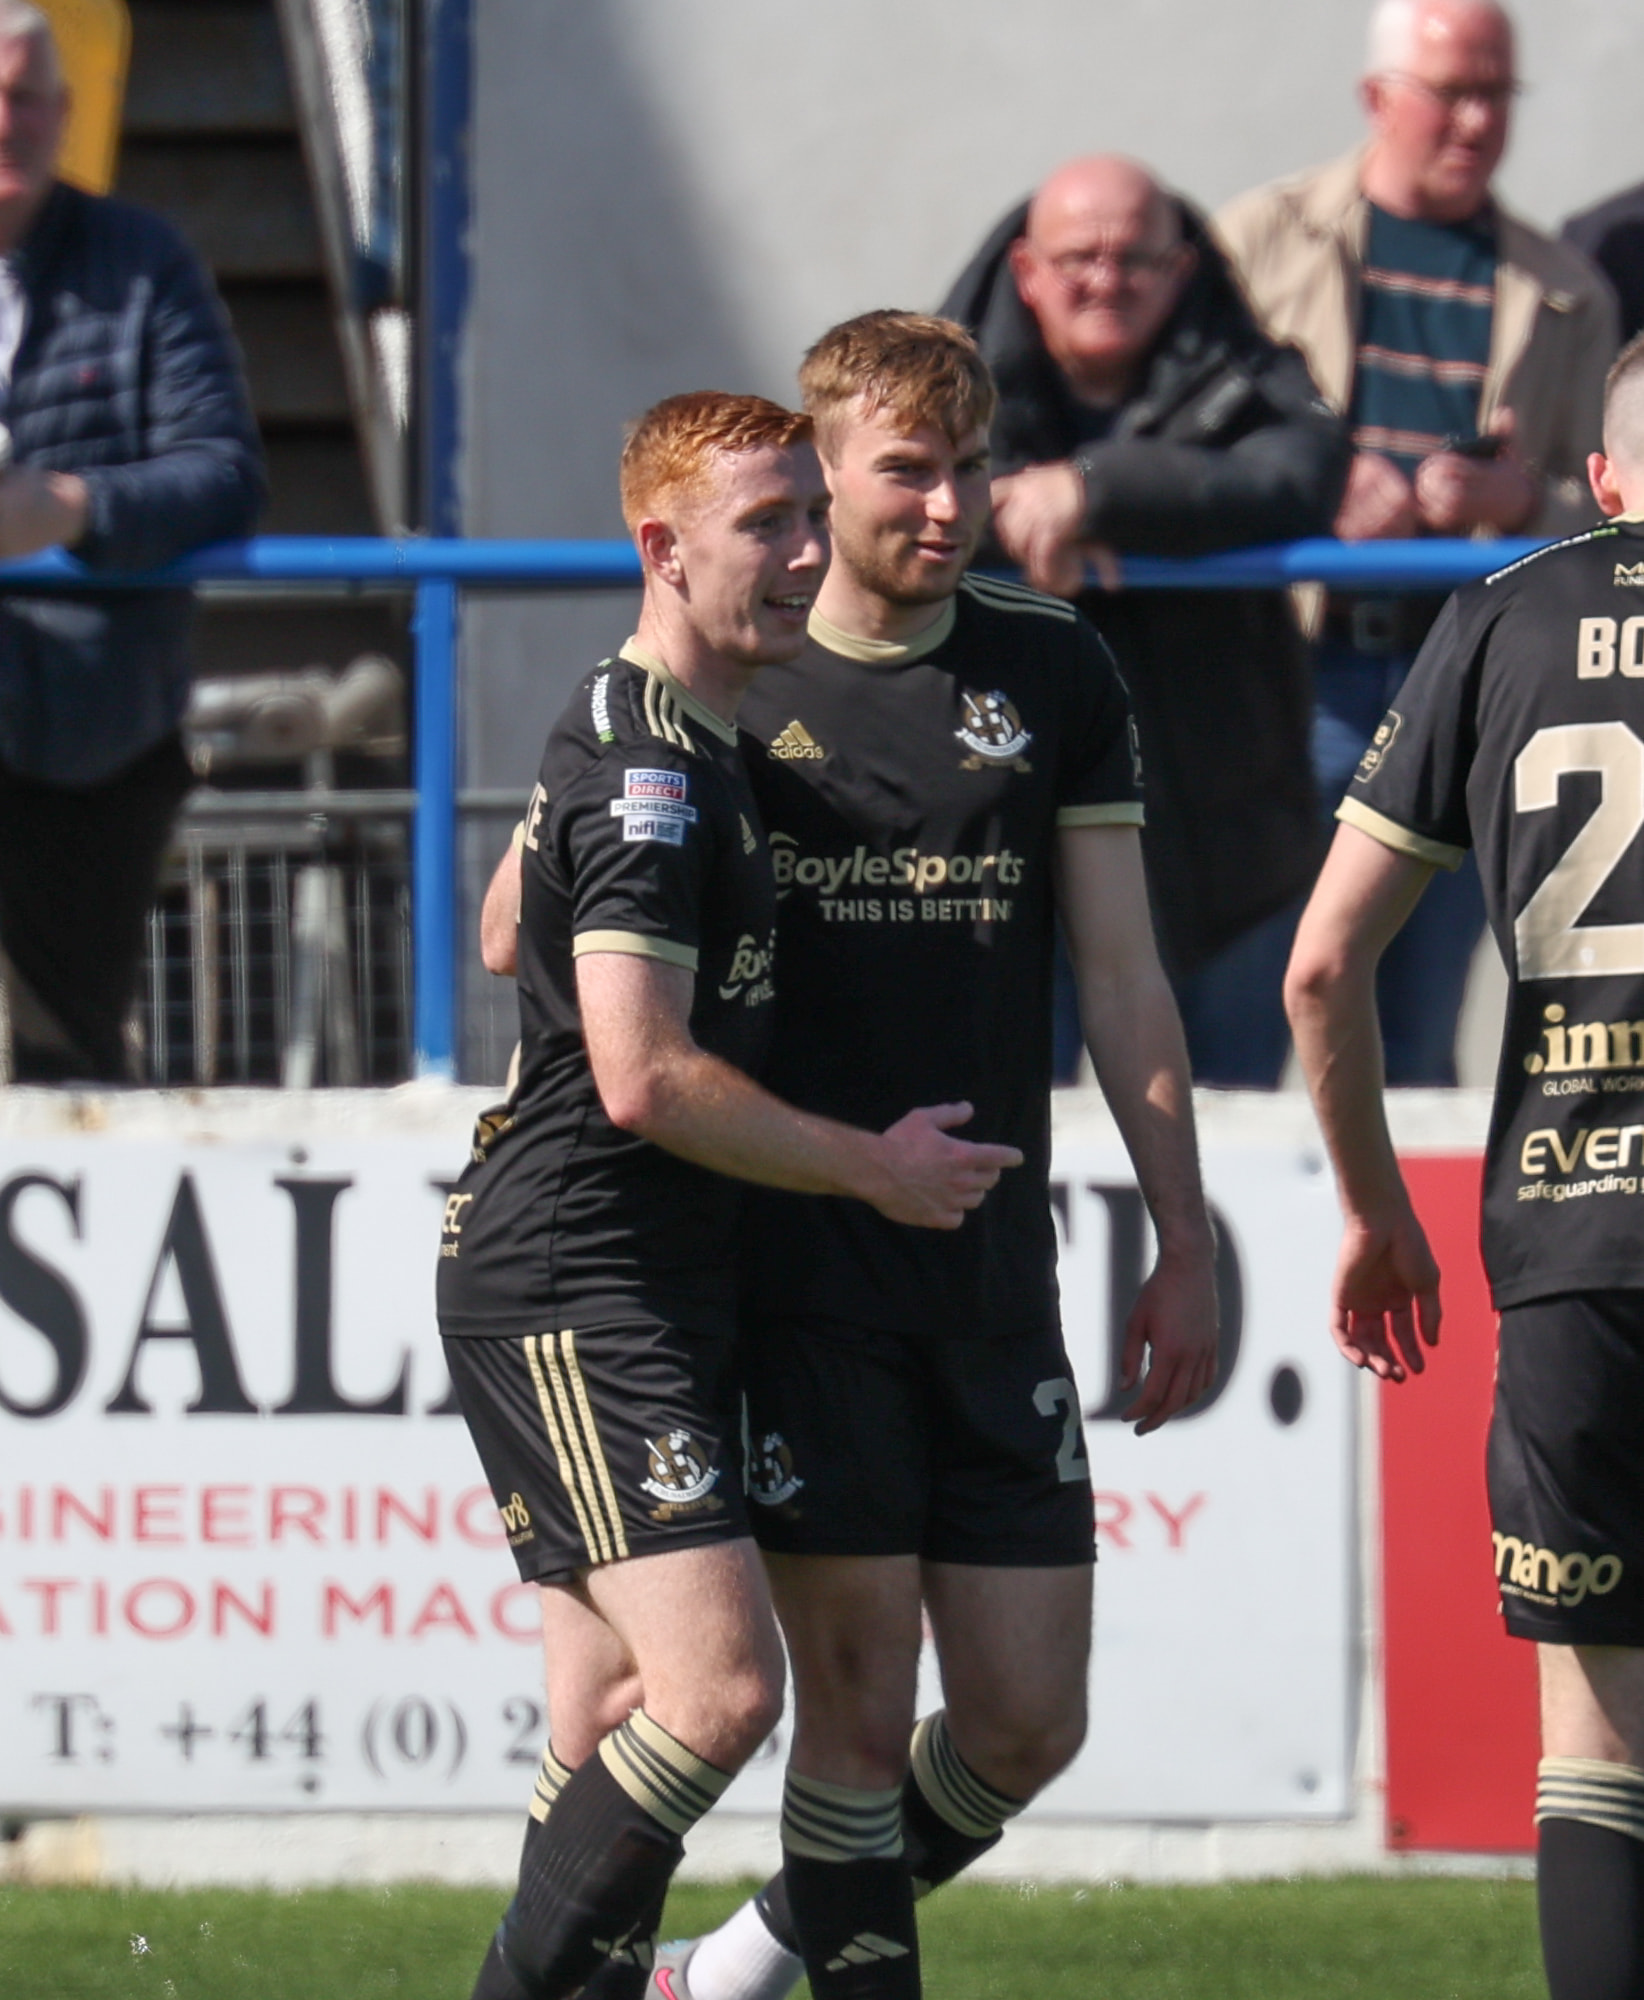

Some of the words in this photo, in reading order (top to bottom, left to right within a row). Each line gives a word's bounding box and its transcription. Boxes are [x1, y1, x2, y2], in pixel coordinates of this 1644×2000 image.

[768, 746, 824, 759] adidas
[631, 773, 681, 785] SPORTS
[631, 785, 680, 797] DIRECT
[614, 801, 694, 817] PREMIERSHIP
[628, 820, 655, 835] nifl
[772, 845, 1026, 894] BoyleSports
[819, 898, 883, 921] THIS
[889, 898, 915, 921] IS
[921, 898, 1012, 921] BETTIN
[1542, 1078, 1597, 1096] GLOBAL
[1517, 1174, 1637, 1202] safeguarding
[0, 1167, 466, 1420] SAL
[0, 1483, 503, 1547] INEERING
[0, 1578, 276, 1640] TION
[32, 1692, 115, 1764] T:
[360, 1692, 470, 1782] (0)
